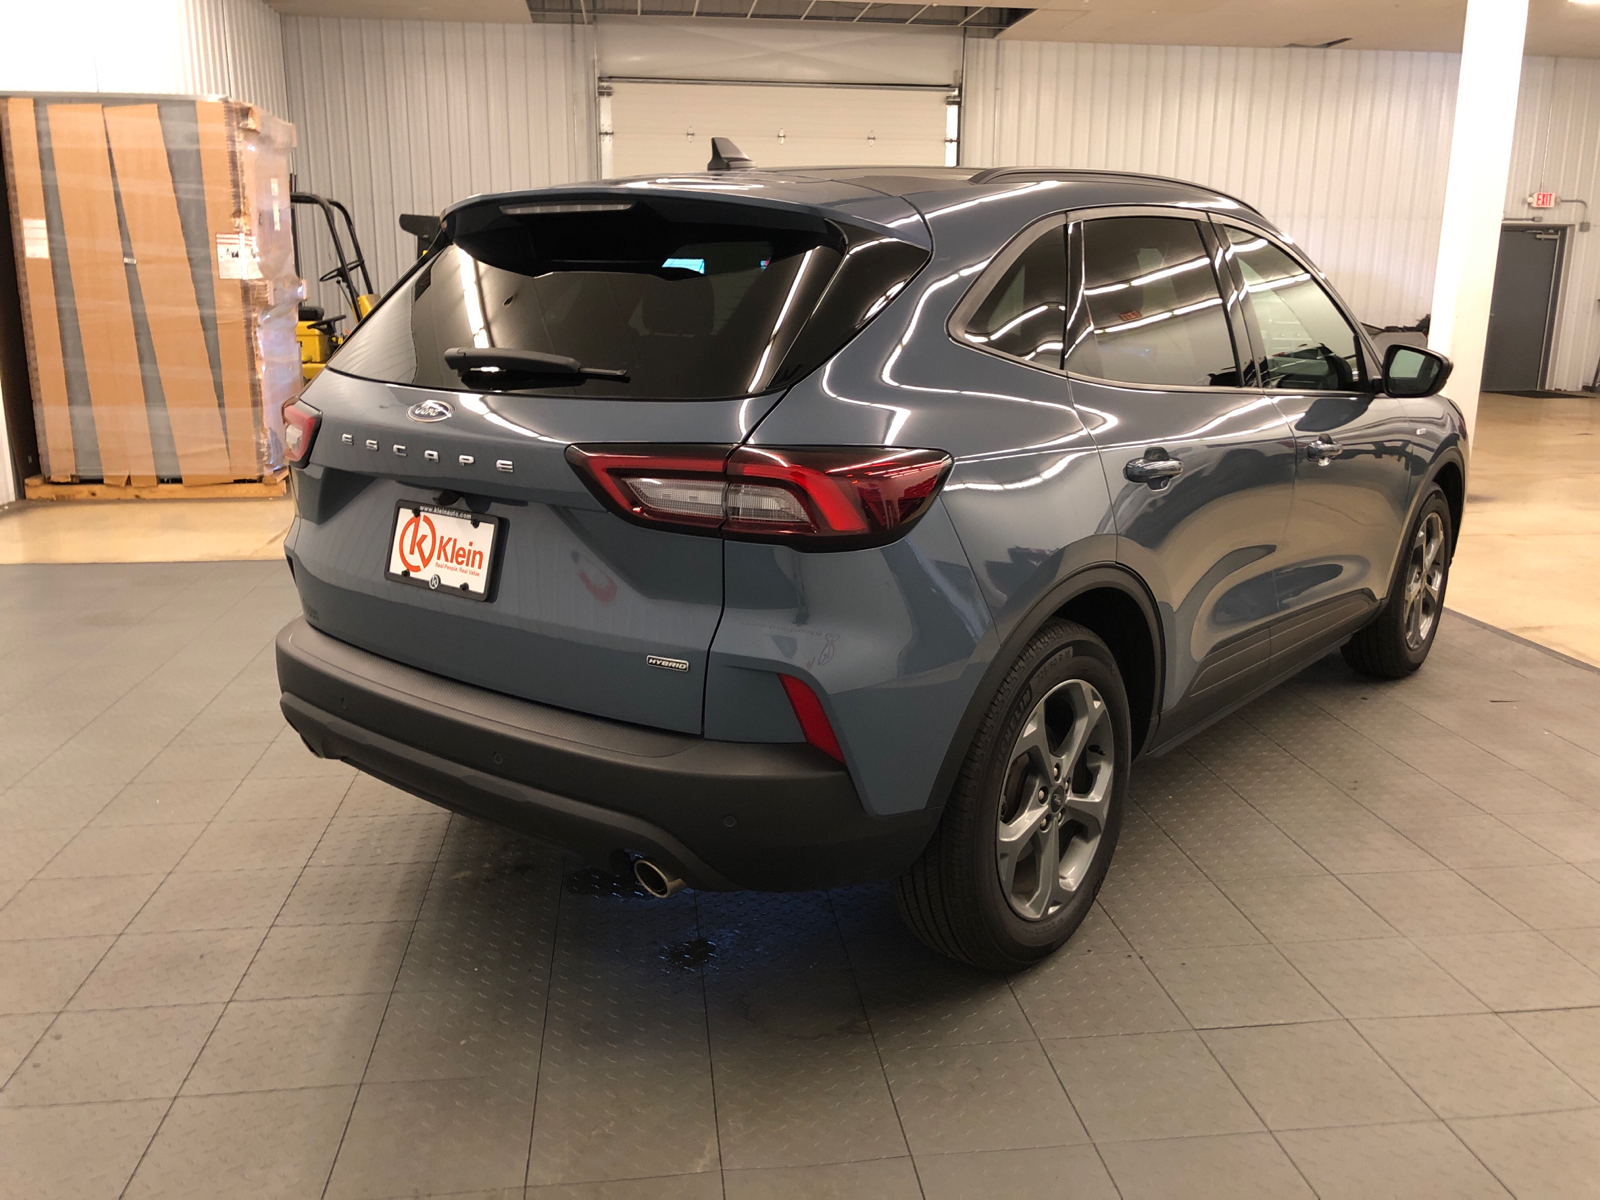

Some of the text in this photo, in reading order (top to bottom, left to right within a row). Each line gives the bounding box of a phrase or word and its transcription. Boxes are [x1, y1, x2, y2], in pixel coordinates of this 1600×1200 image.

[1536, 193, 1553, 206] EXIT
[341, 433, 514, 473] ESCAPE
[419, 505, 472, 520] www.kleinauto.com
[437, 536, 484, 570] Klein
[459, 567, 468, 575] Real
[649, 658, 687, 669] HYBRID
